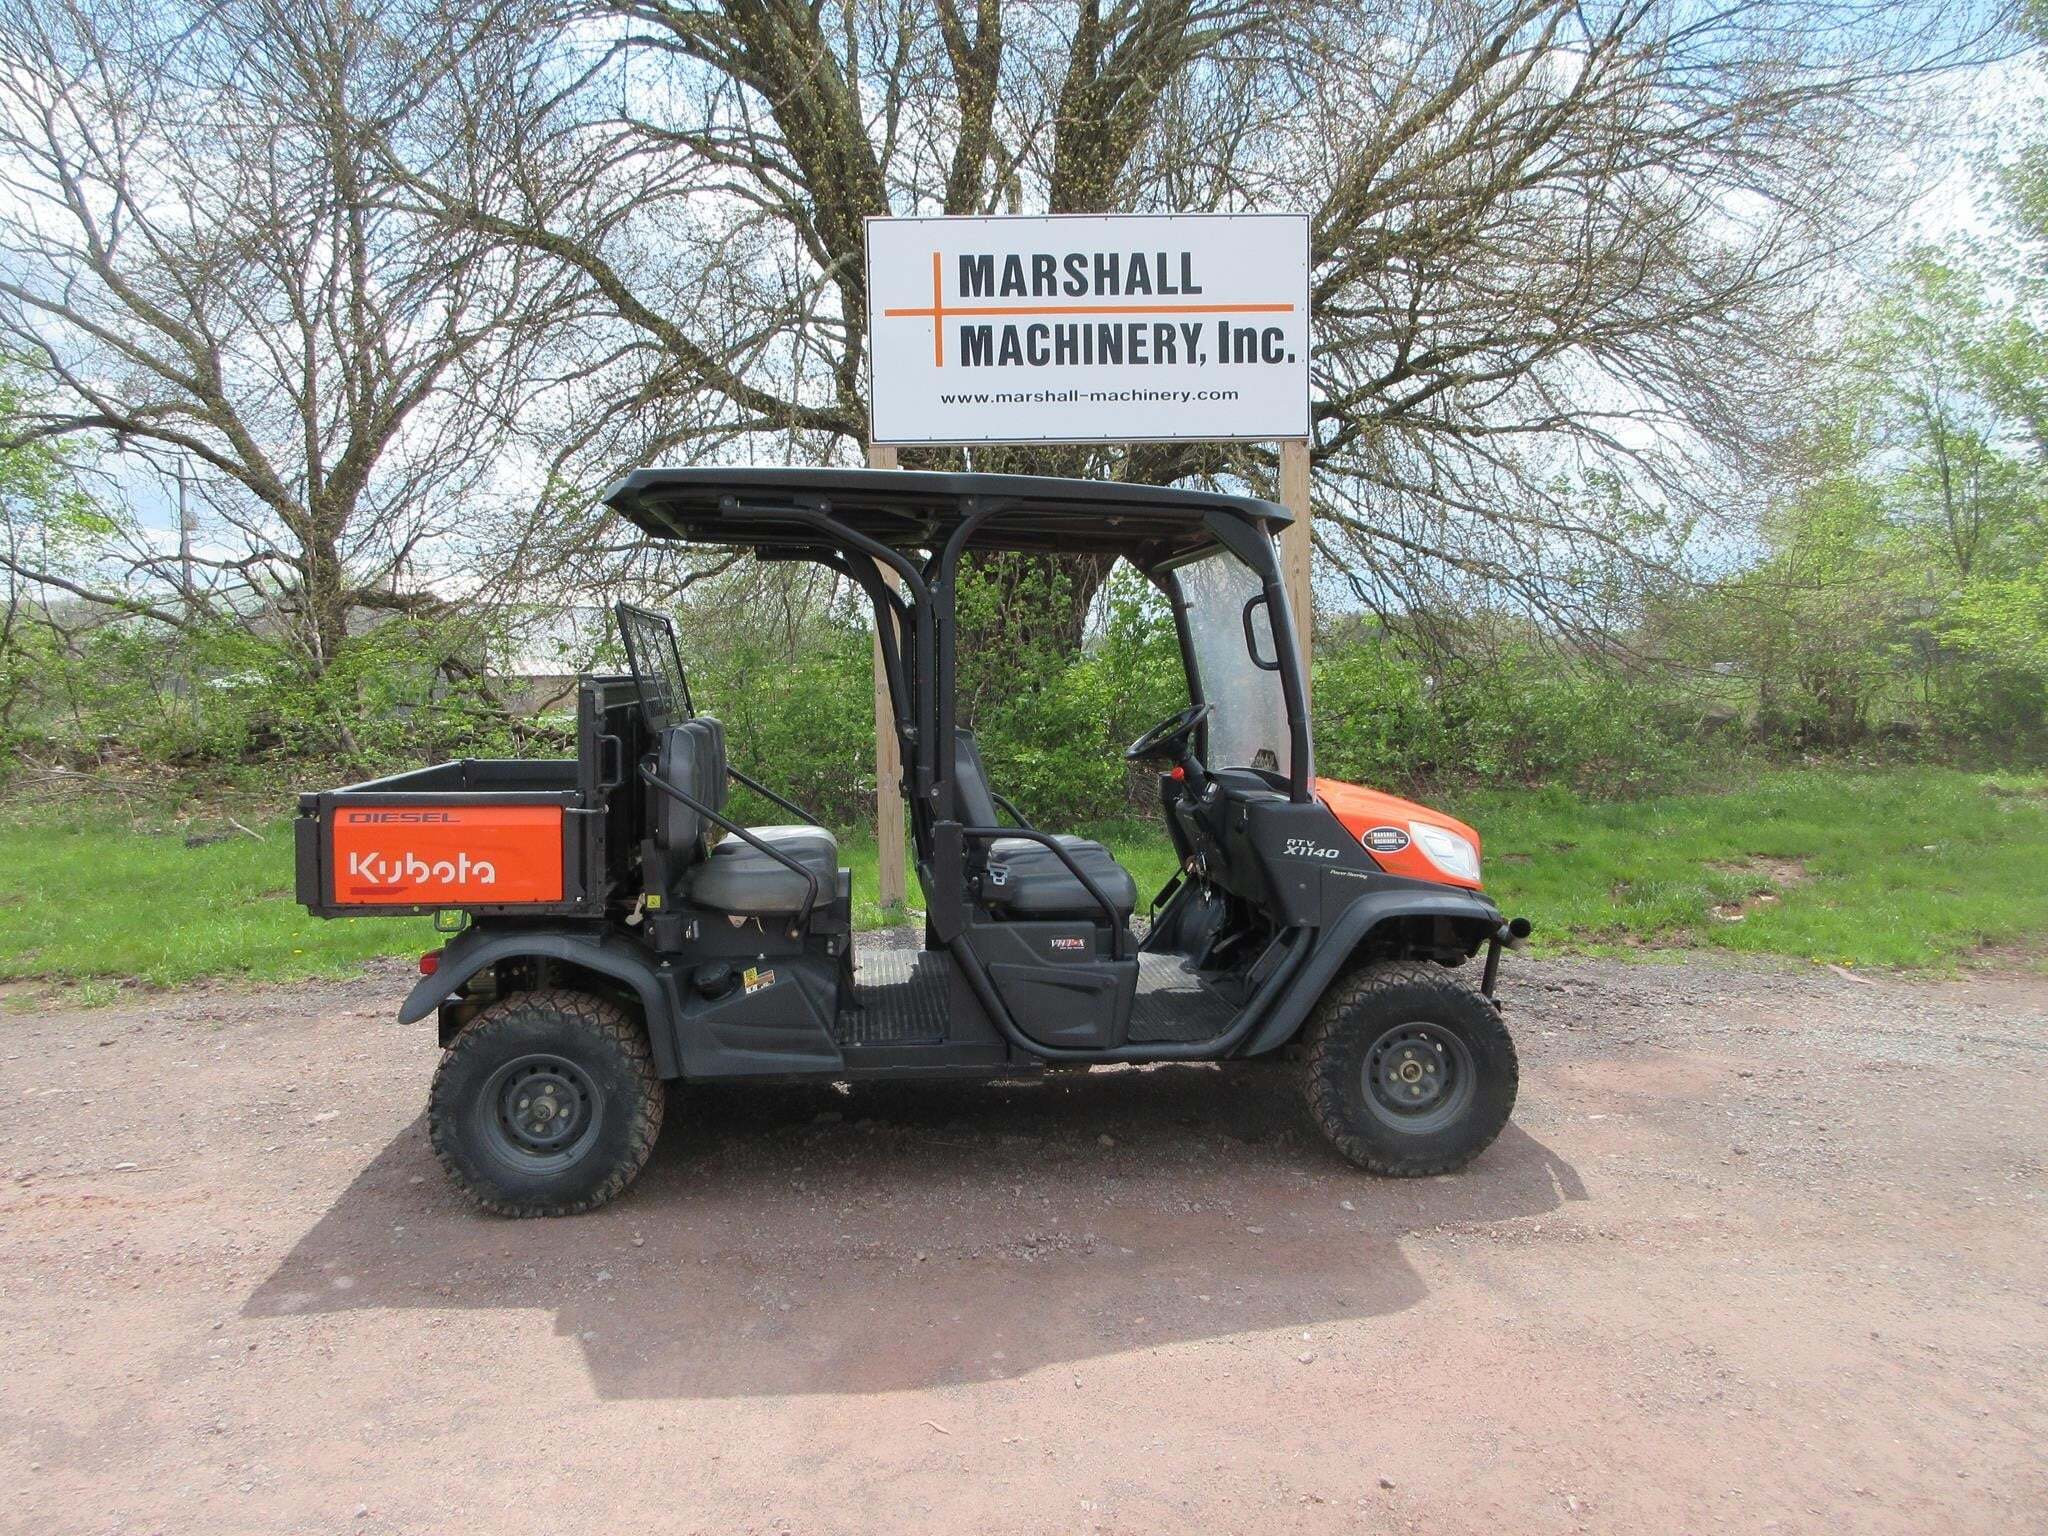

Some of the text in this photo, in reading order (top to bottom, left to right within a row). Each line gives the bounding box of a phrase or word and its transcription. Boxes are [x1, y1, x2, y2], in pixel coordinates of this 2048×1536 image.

[959, 252, 1203, 297] MARSHALL
[960, 320, 1296, 368] MACHINERY, Inc.
[941, 388, 1240, 405] www.marshall-machinery.com
[349, 812, 461, 823] DIESEL
[1283, 846, 1340, 858] X1140
[350, 852, 496, 884] Kubota
